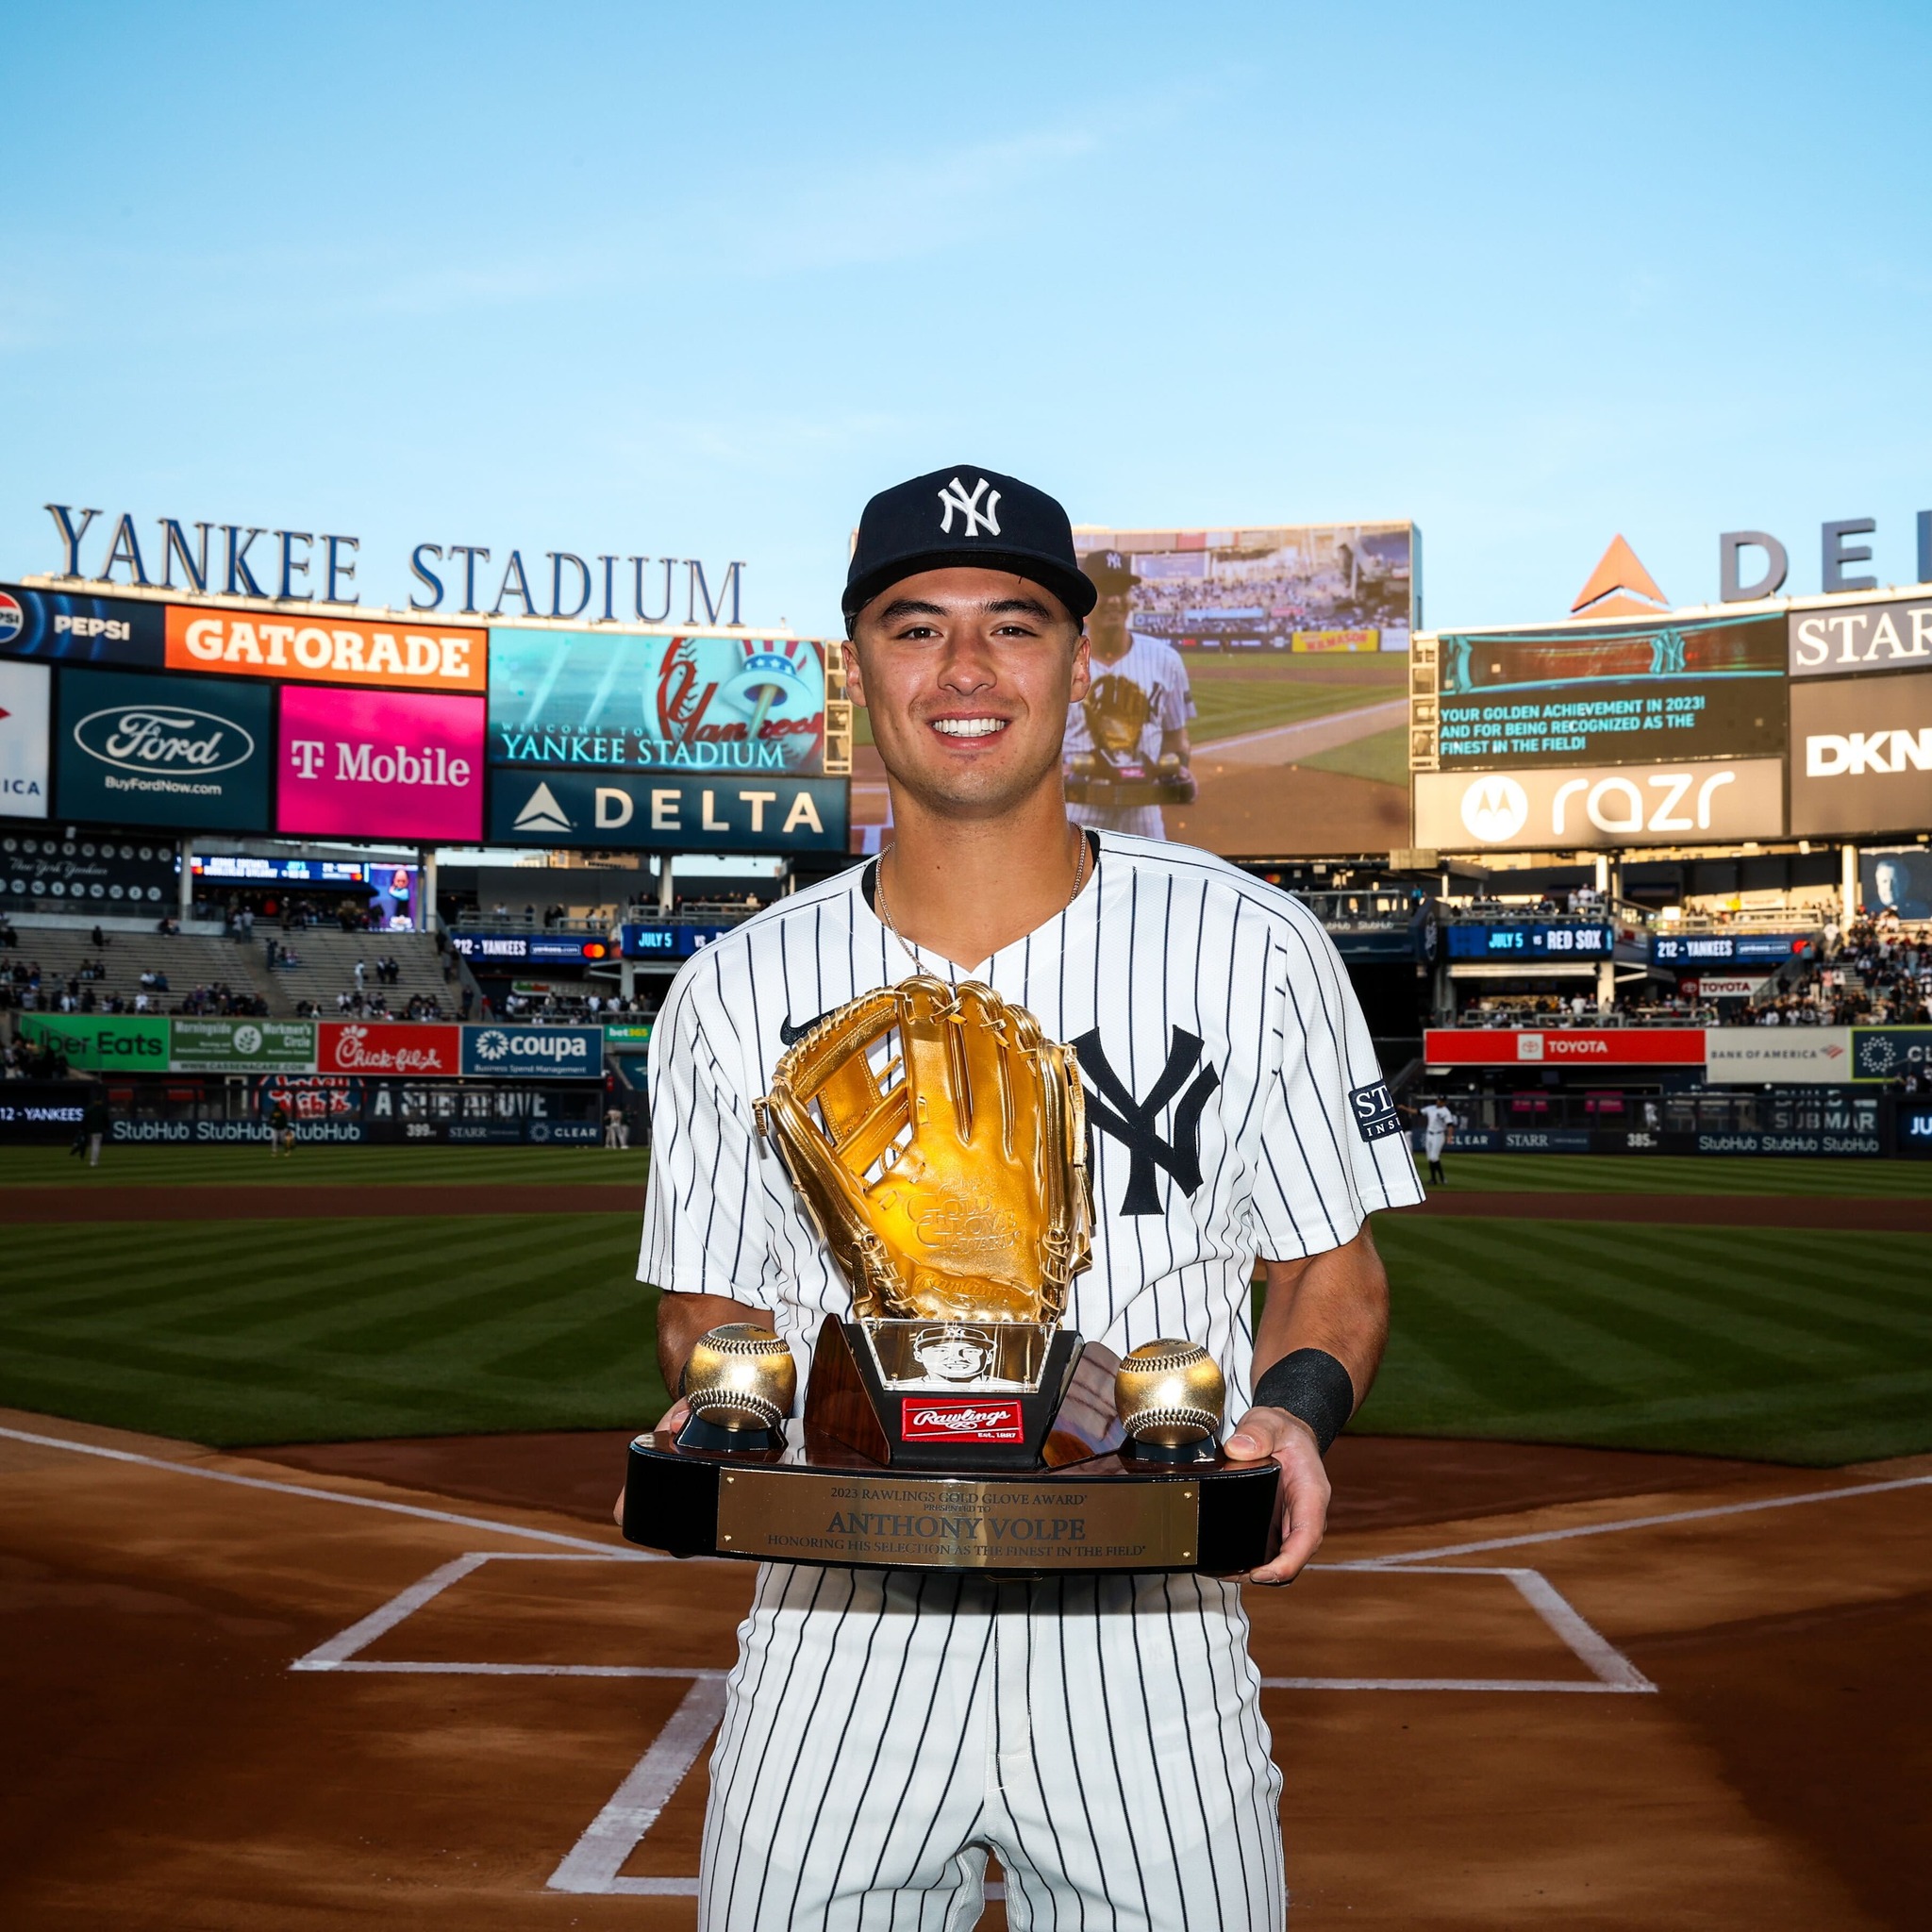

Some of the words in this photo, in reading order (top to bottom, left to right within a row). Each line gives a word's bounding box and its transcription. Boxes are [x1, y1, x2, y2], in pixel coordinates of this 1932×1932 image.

[938, 477, 1001, 537] NY
[43, 504, 360, 605] YANKEE
[408, 543, 746, 627] STADIUM
[55, 615, 130, 641] PEPSI
[185, 619, 470, 677] GATORADE
[1441, 709, 1479, 723] YOUR
[1483, 706, 1540, 721] GOLDEN
[1543, 700, 1643, 718] ACHIEVEMENT
[1646, 699, 1662, 712] IN
[1666, 696, 1706, 711] 2023!
[502, 722, 603, 736] WELCOME
[620, 725, 643, 738] TO
[1441, 724, 1471, 739] AND
[1474, 723, 1501, 738] FOR
[1506, 721, 1547, 736] BEING
[1551, 717, 1640, 735] RECOGNIZED
[1643, 715, 1663, 730] AS
[1666, 713, 1695, 728] THE
[106, 712, 224, 764] Ford
[1440, 741, 1489, 755] FINEST
[1492, 739, 1507, 753] IN
[1510, 738, 1539, 752] THE
[1541, 736, 1586, 751] FIELD!
[502, 733, 625, 764] YANKEE
[638, 738, 786, 769] STADIUM
[1806, 727, 1932, 777] DKN
[335, 742, 470, 787] Mobile
[0, 778, 41, 795] ICA
[105, 775, 222, 794] BuyFordNow.com
[595, 787, 824, 835] DELTA
[1552, 771, 1736, 836] razr
[482, 940, 526, 956] YANKEES
[639, 932, 662, 948] JULY
[664, 932, 673, 948] 5
[1489, 932, 1513, 949] JULY
[1515, 932, 1524, 948] 5
[1547, 930, 1573, 950] RED
[1575, 930, 1602, 950] SOX
[1657, 941, 1677, 958] 212
[1686, 940, 1733, 958] YANKEES
[1702, 982, 1751, 993] TOYOTA
[609, 1027, 648, 1038] bet365
[41, 1029, 92, 1055] ber
[98, 1032, 162, 1056] Eats
[510, 1036, 587, 1062] coupa
[1548, 1041, 1607, 1053] TOYOTA
[1711, 1050, 1742, 1059] BANK
[1746, 1050, 1760, 1059] OF
[1763, 1050, 1817, 1059] AMERICA
[475, 1064, 508, 1074] Business
[509, 1064, 533, 1074] Spend
[535, 1065, 587, 1075] Management
[1356, 1085, 1394, 1119] ST
[24, 1108, 84, 1122] YANKEES
[113, 1121, 190, 1140] StubHub
[196, 1122, 274, 1141] StubHub
[448, 1127, 488, 1138] STARR
[555, 1127, 597, 1138] CLEAR
[1507, 1135, 1548, 1146] STARR
[1627, 1134, 1650, 1146] 385
[1699, 1136, 1757, 1150] StubHub
[1762, 1136, 1818, 1151] StubHub
[1823, 1137, 1879, 1152] StubHub
[913, 1408, 1011, 1426] Rawlings
[831, 1488, 858, 1499] 2023
[862, 1489, 936, 1503] RAWLINGS
[939, 1491, 978, 1504] GOLD
[982, 1493, 1029, 1505] GLOVE
[924, 1504, 975, 1512] PRESENTED
[977, 1505, 991, 1513] TO
[826, 1511, 983, 1540] ANTHONY
[989, 1517, 1086, 1541] VOLPE
[768, 1534, 844, 1550] HONORING
[848, 1541, 871, 1552] HIS
[874, 1541, 951, 1555] SELECTION
[954, 1545, 971, 1556] AS
[974, 1545, 1003, 1557] THE
[1006, 1546, 1053, 1557] FINEST
[1057, 1546, 1072, 1557] IN
[1074, 1545, 1103, 1557] THE
